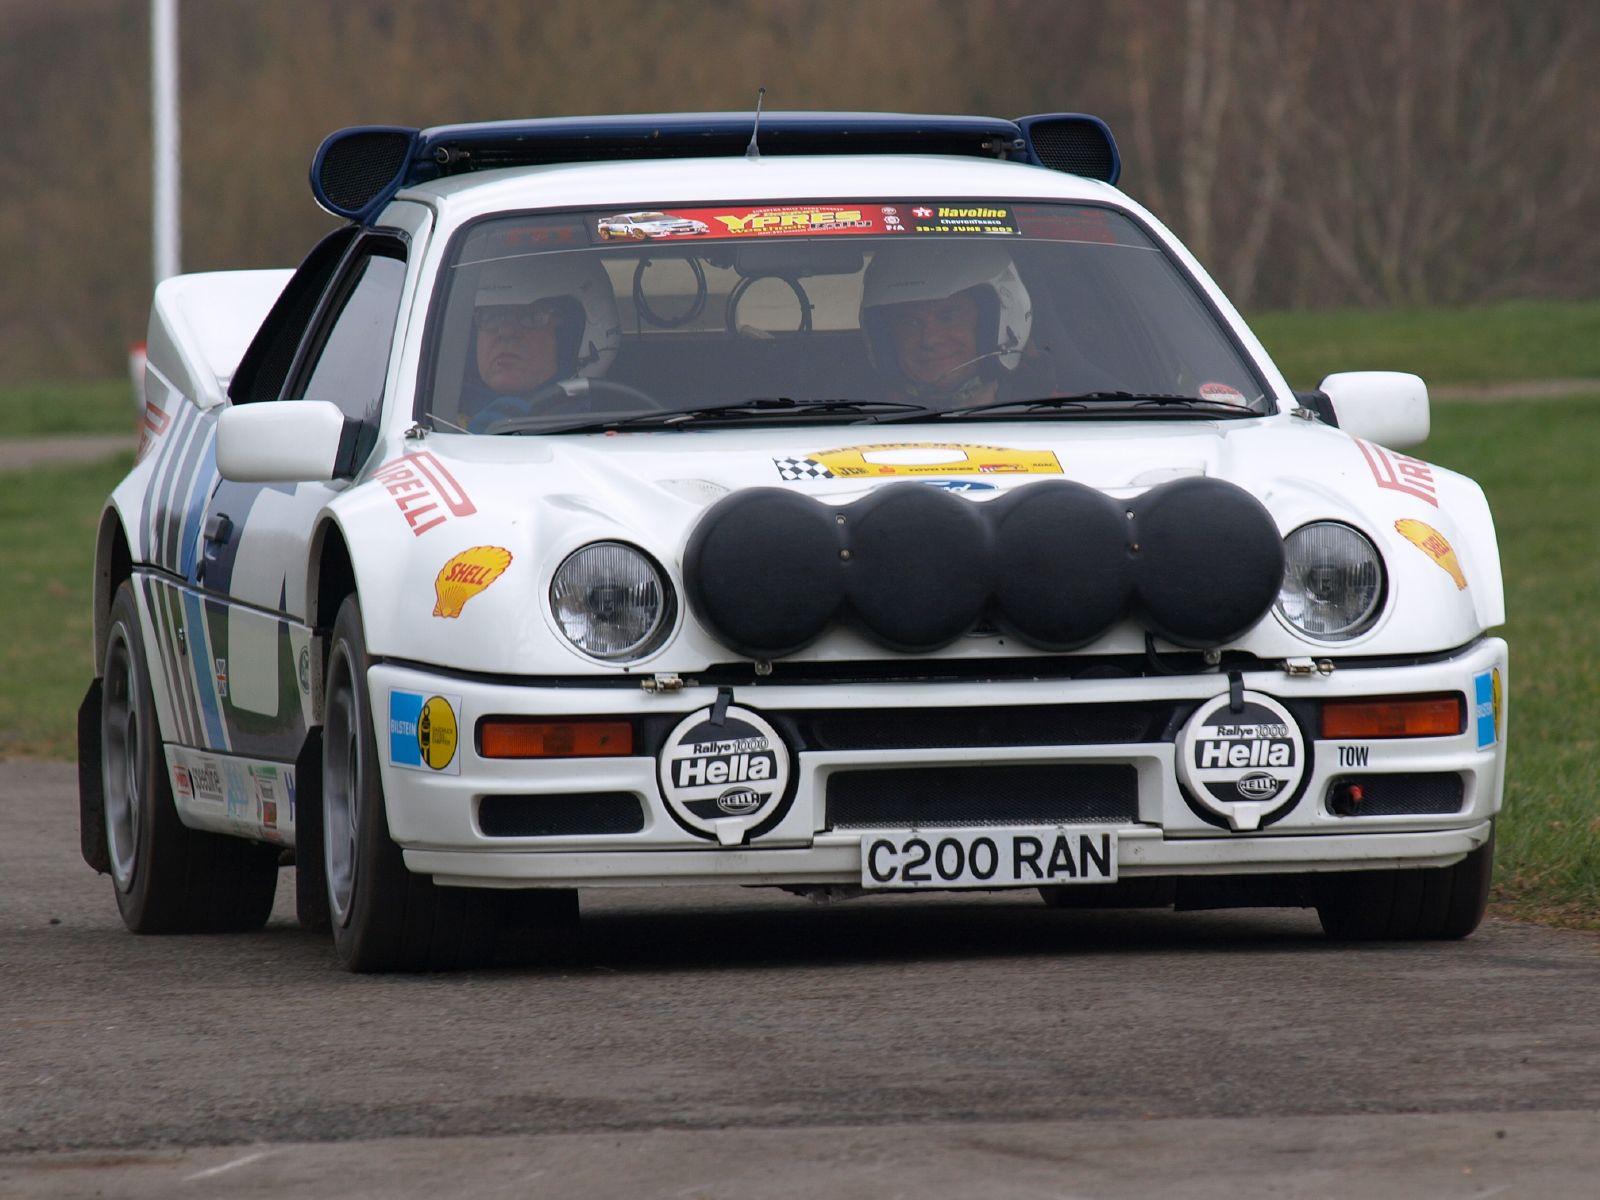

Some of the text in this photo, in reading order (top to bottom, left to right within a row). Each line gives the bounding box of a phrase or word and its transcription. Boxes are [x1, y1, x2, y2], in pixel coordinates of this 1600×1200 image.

[713, 211, 861, 230] YPRES
[938, 207, 1007, 218] Havoline
[445, 562, 492, 586] SHELL
[1217, 724, 1289, 738] Rallye 1000
[693, 736, 769, 754] Rallye 1000
[1201, 740, 1290, 768] Hella
[1337, 746, 1369, 767] TOW
[679, 754, 771, 787] Hella
[1240, 778, 1278, 790] HELLA
[720, 791, 760, 805] HELLA
[868, 833, 1111, 882] C200 RAN
